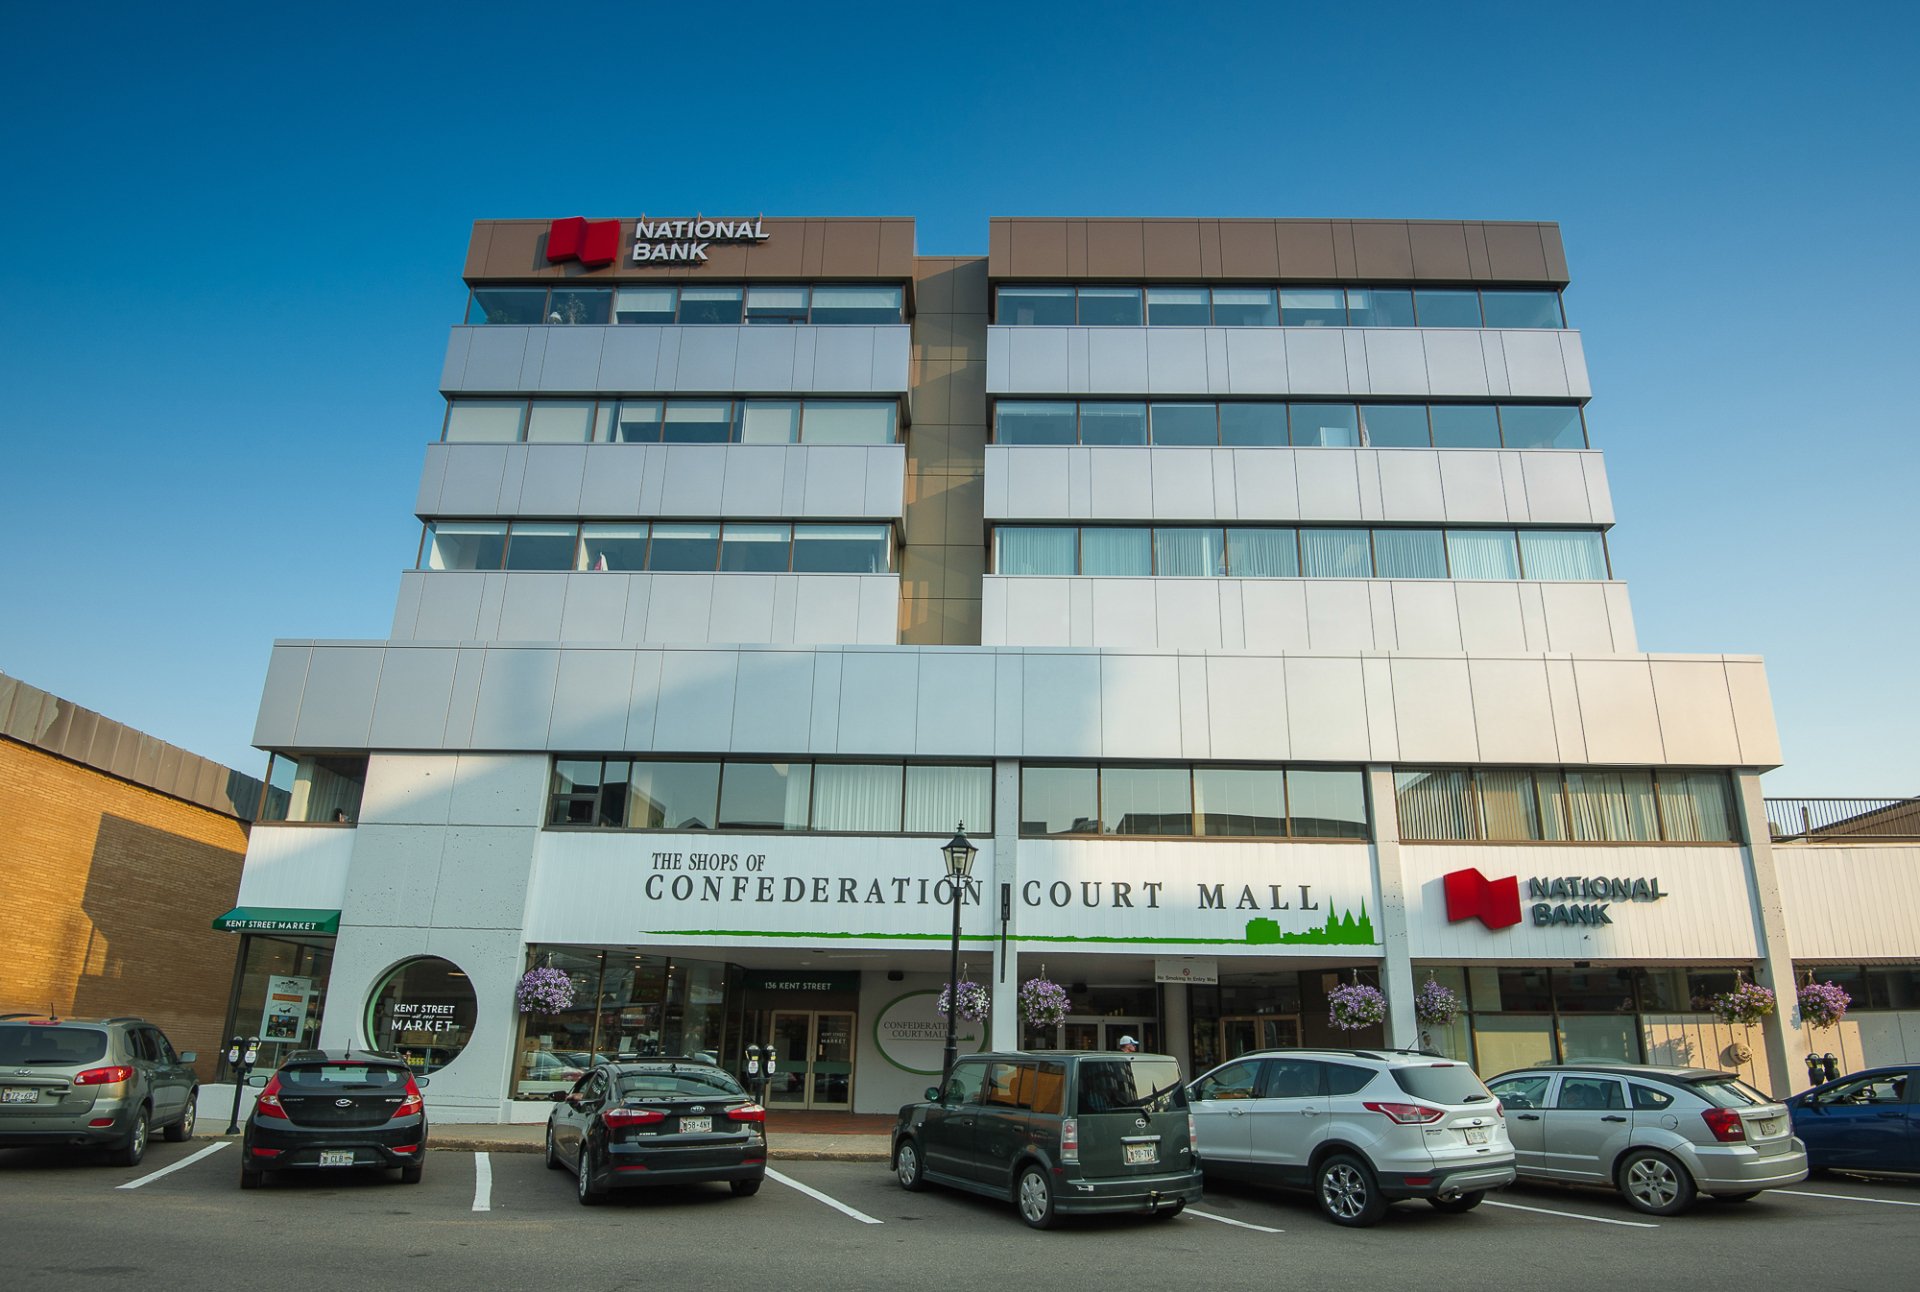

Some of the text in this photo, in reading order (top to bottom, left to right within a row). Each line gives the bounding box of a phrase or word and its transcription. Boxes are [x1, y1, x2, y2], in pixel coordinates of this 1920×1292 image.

[635, 220, 770, 239] NATIONAL
[632, 242, 710, 261] BANK
[651, 852, 766, 872] THE SHOPS OF
[645, 874, 1319, 911] CONFEDERATION COURT MALL
[1529, 876, 1669, 900] NATIONAL
[1532, 903, 1613, 926] BANK
[225, 920, 317, 930] KENT STREET MARKET
[802, 982, 832, 990] STREET
[394, 1004, 455, 1014] KENT STREET
[391, 1020, 453, 1032] MARKET
[892, 1030, 923, 1038] COURT
